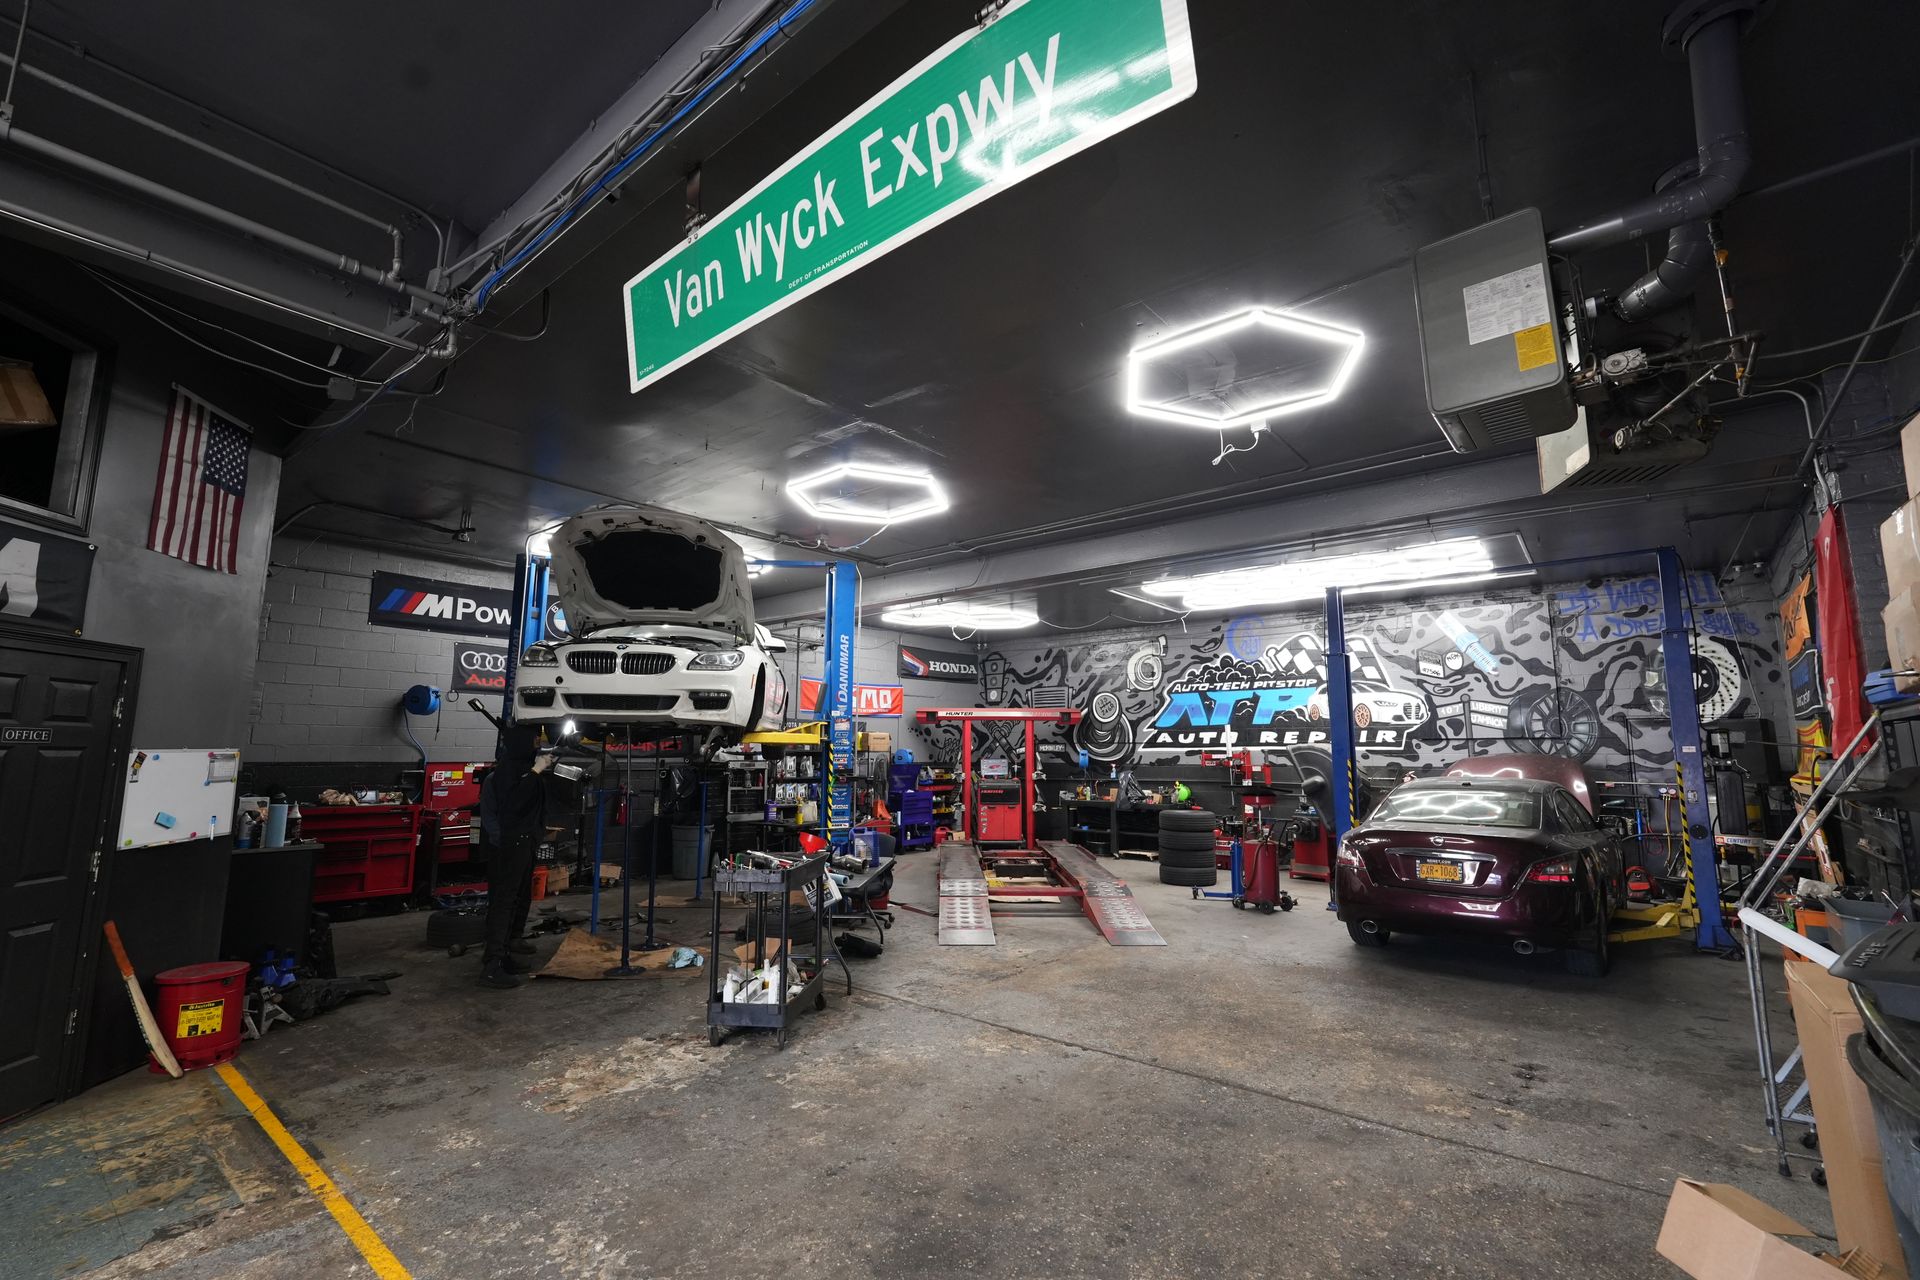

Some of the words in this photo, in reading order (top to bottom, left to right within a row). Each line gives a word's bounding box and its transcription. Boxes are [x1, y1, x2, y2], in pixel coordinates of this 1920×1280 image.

[664, 257, 724, 328] Van
[735, 170, 845, 283] Wyck
[859, 32, 1061, 208] Expwy
[788, 276, 803, 289] DEPT
[804, 271, 813, 280] OF
[813, 239, 869, 274] TRANSPORTATION
[1576, 613, 1599, 642] A
[837, 634, 849, 703] DANNMAR
[929, 661, 977, 674] HONDA
[465, 674, 507, 687] Aud
[1172, 681, 1251, 693] AUTO-TECH
[1253, 678, 1318, 689] PITSTOP
[1155, 687, 1317, 728] ATP
[1471, 701, 1503, 713] LIBERTY
[5, 730, 49, 740] OFFICE
[1259, 730, 1397, 744] REPIR
[1726, 837, 1752, 845] CENTURY
